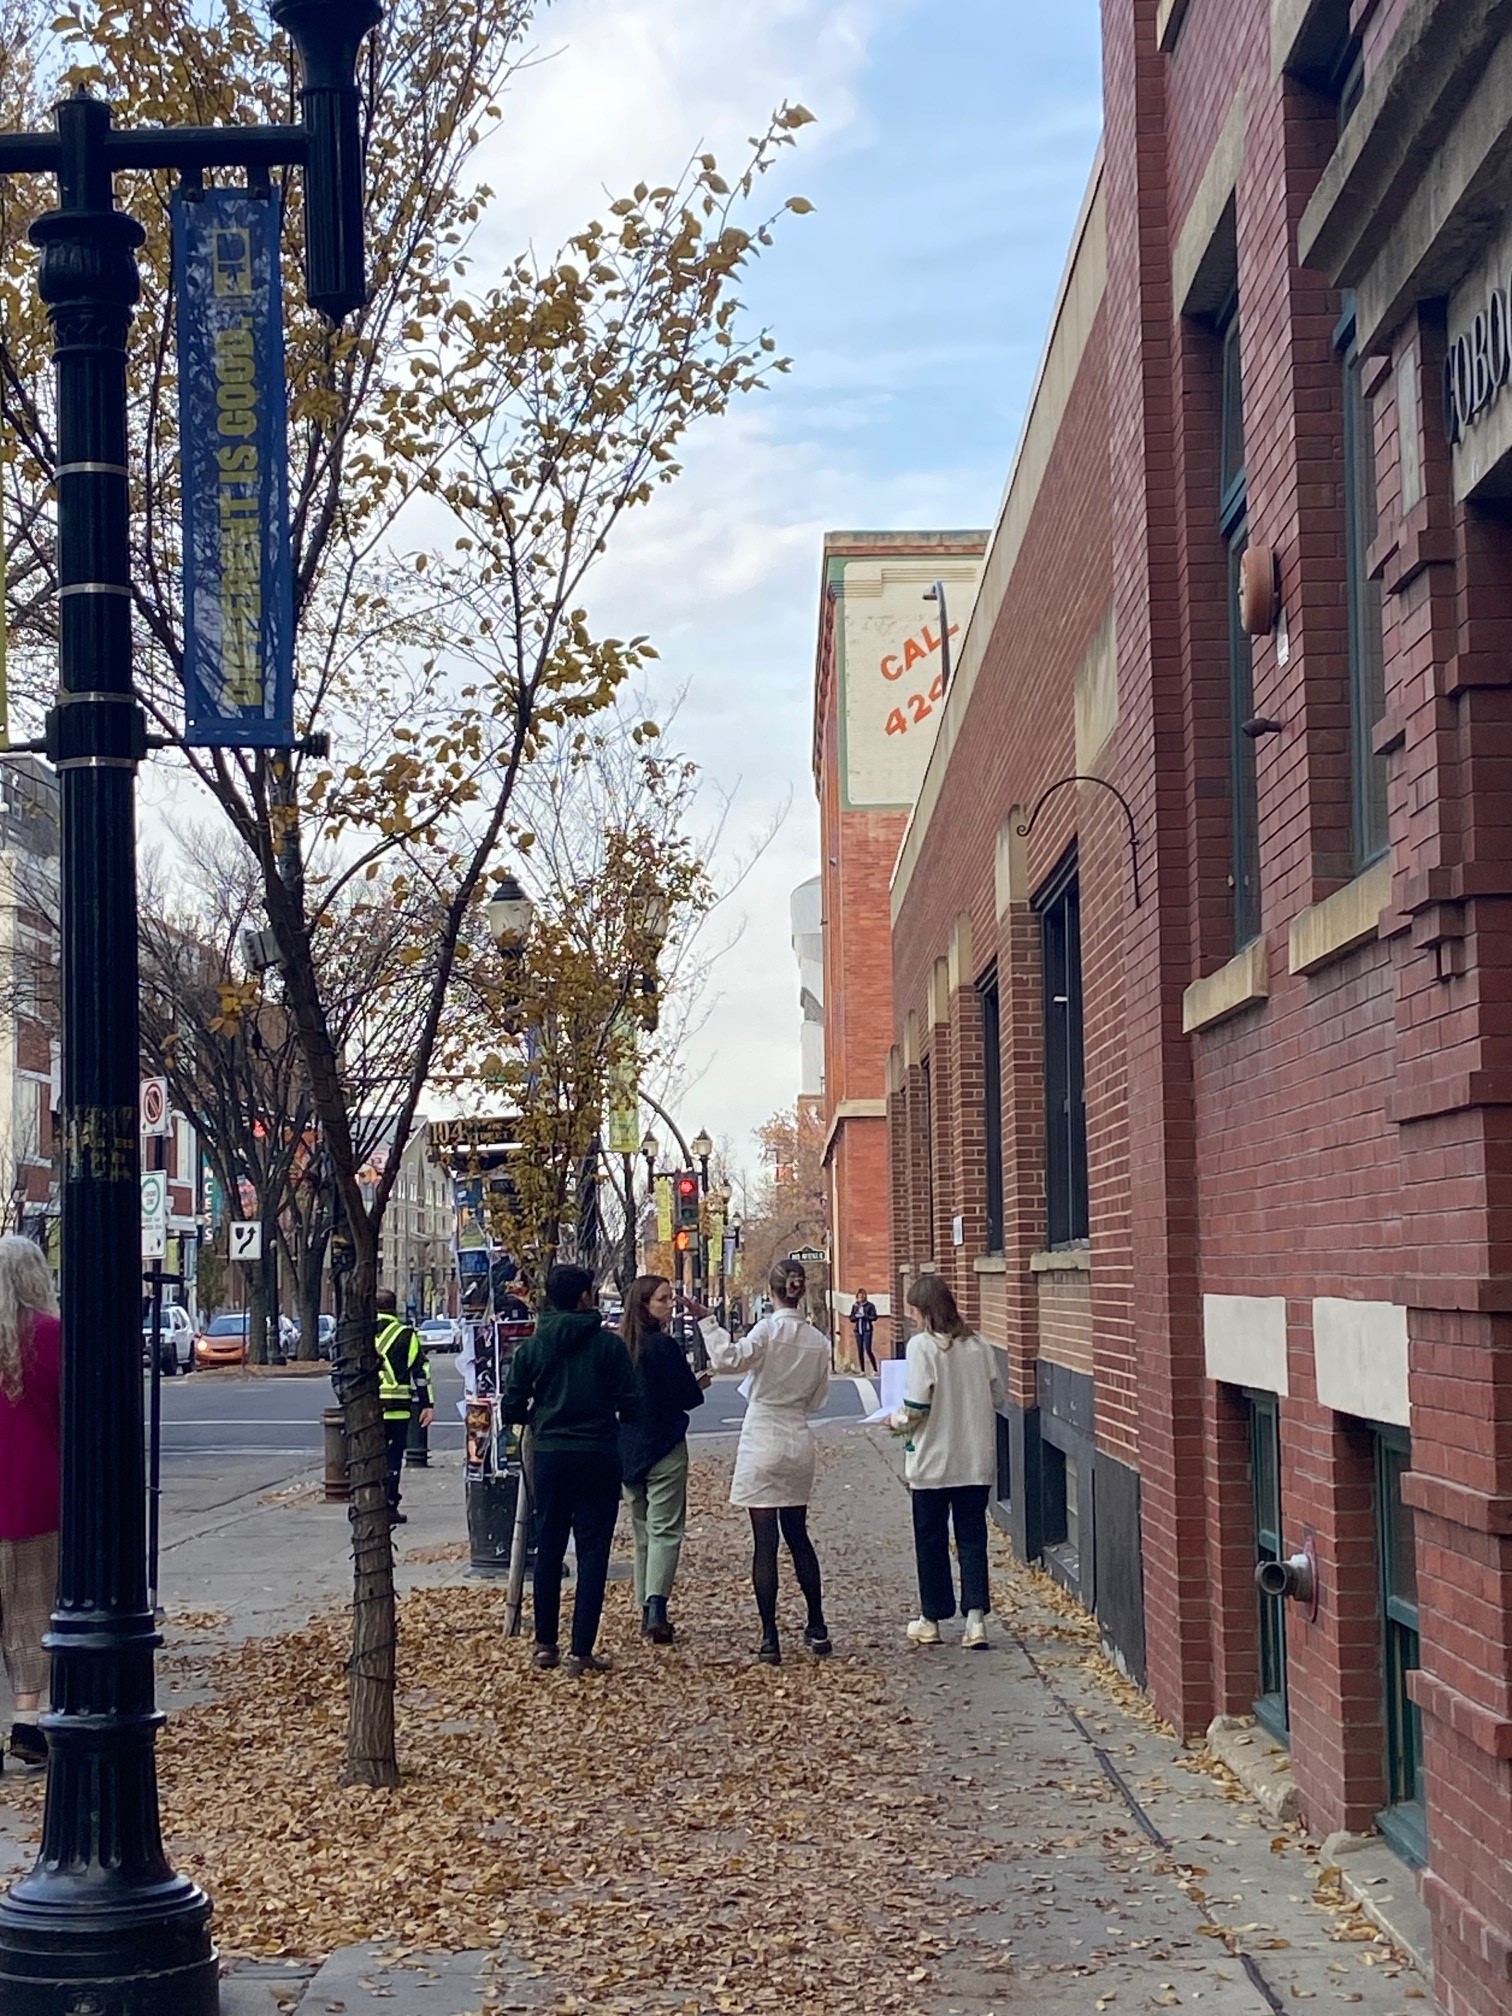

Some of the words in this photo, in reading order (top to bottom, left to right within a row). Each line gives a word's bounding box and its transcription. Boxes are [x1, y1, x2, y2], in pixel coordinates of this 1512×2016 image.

[217, 444, 260, 484] IS
[216, 492, 262, 707] DIFFERENT
[430, 1119, 466, 1145] 104
